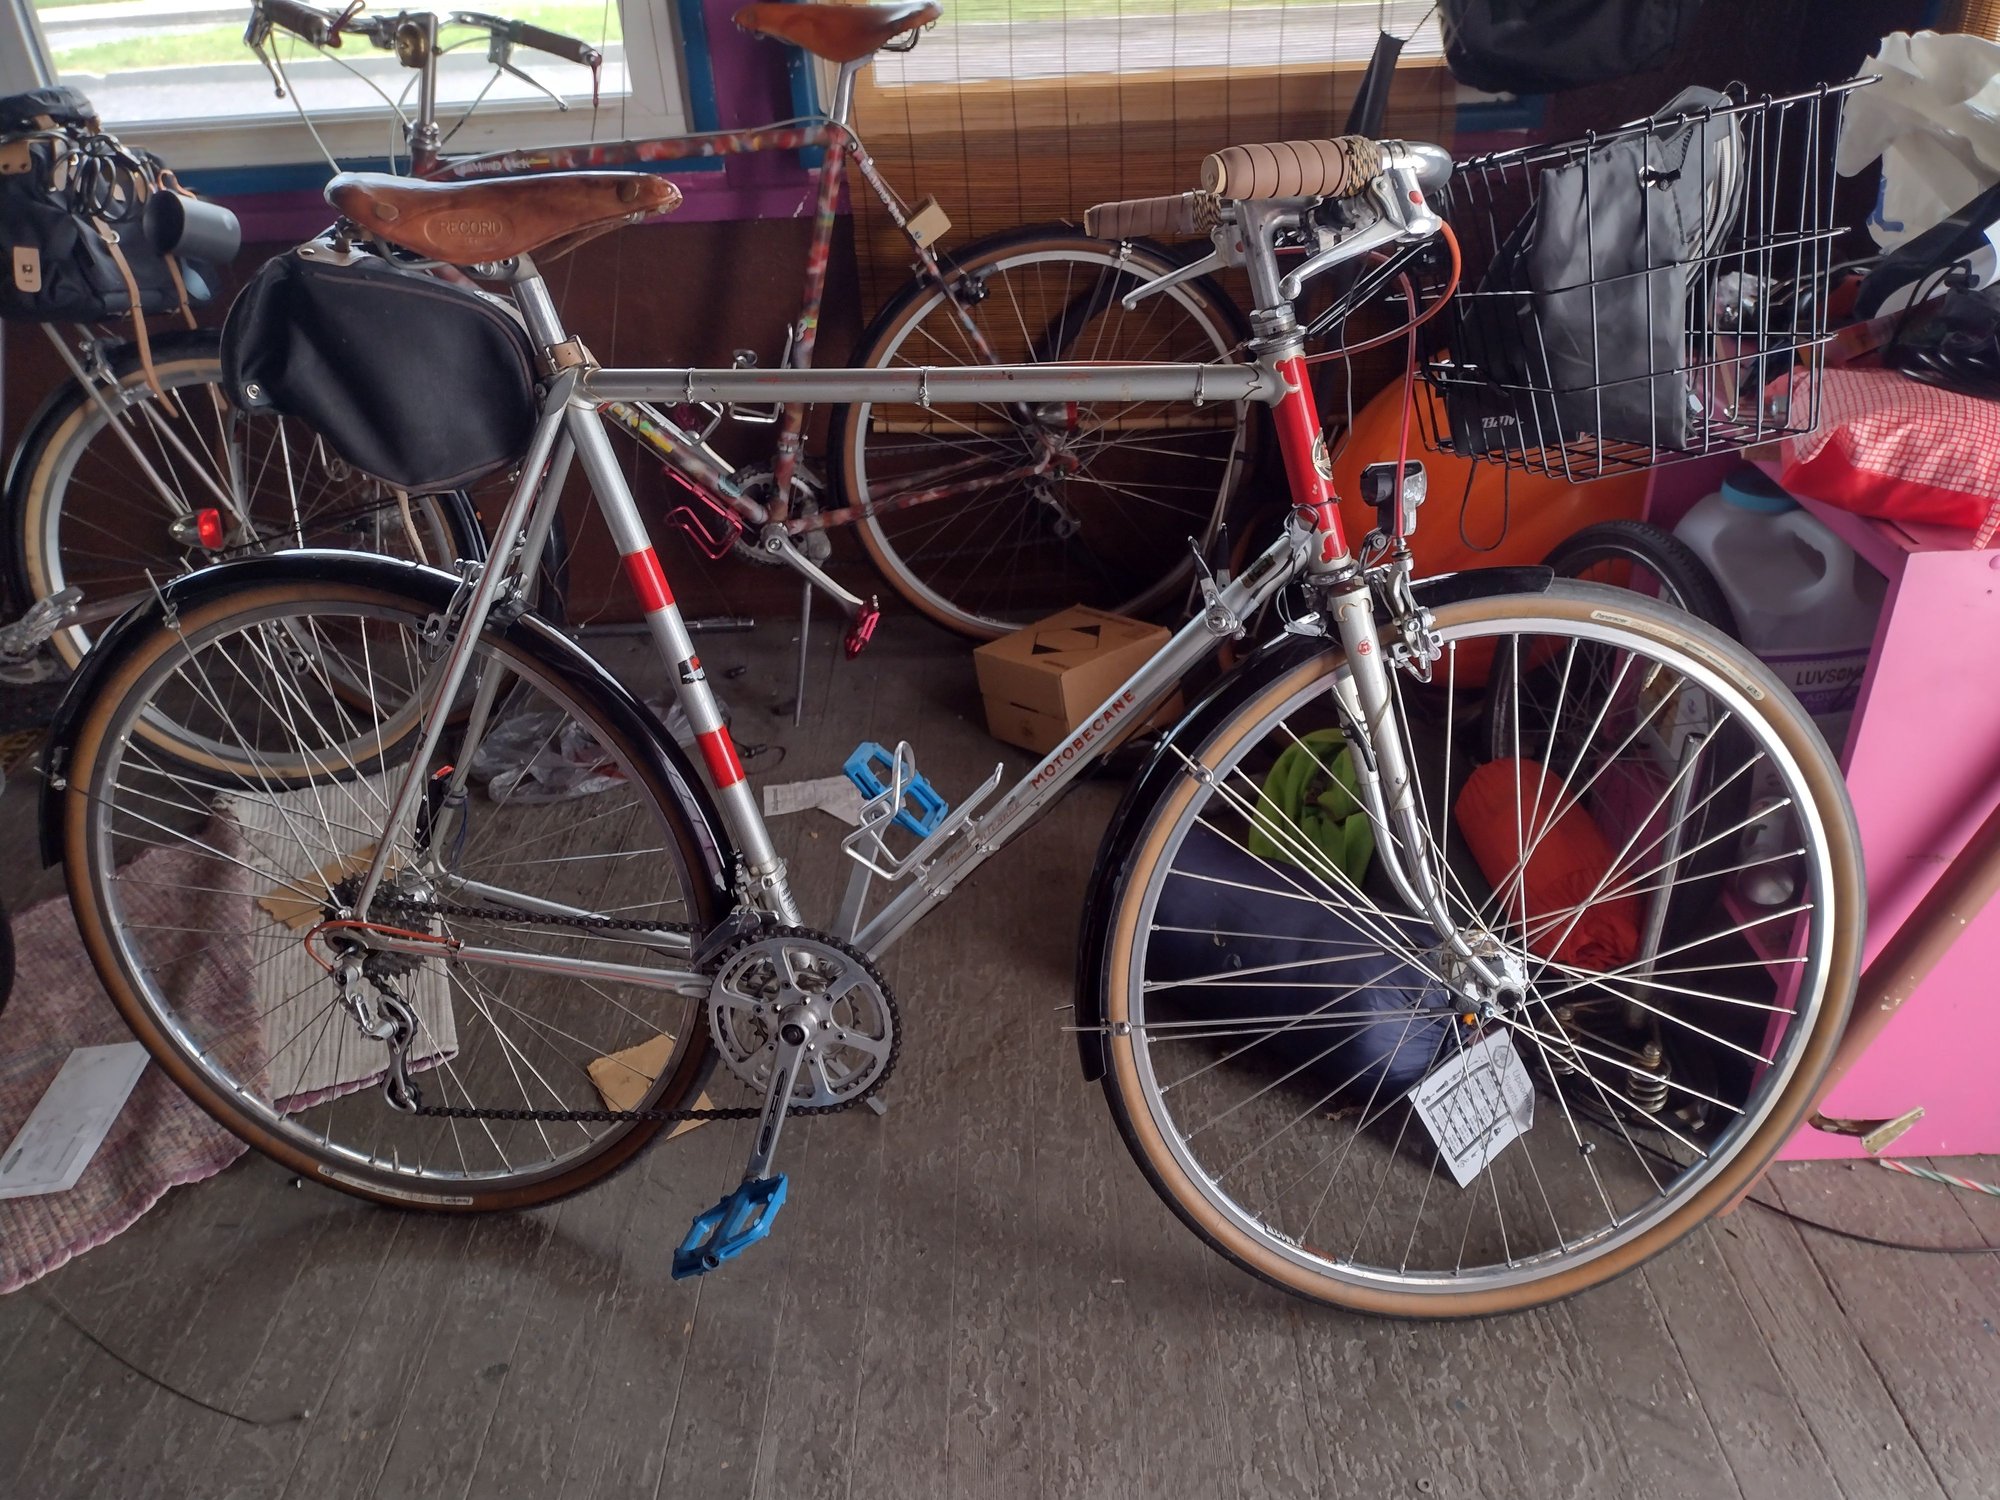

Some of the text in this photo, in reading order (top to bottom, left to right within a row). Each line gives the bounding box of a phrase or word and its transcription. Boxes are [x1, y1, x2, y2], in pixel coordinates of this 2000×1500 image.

[440, 220, 503, 236] RECORD
[1795, 666, 1864, 687] LUVSOM
[1031, 689, 1136, 790] MOTOBECANE
